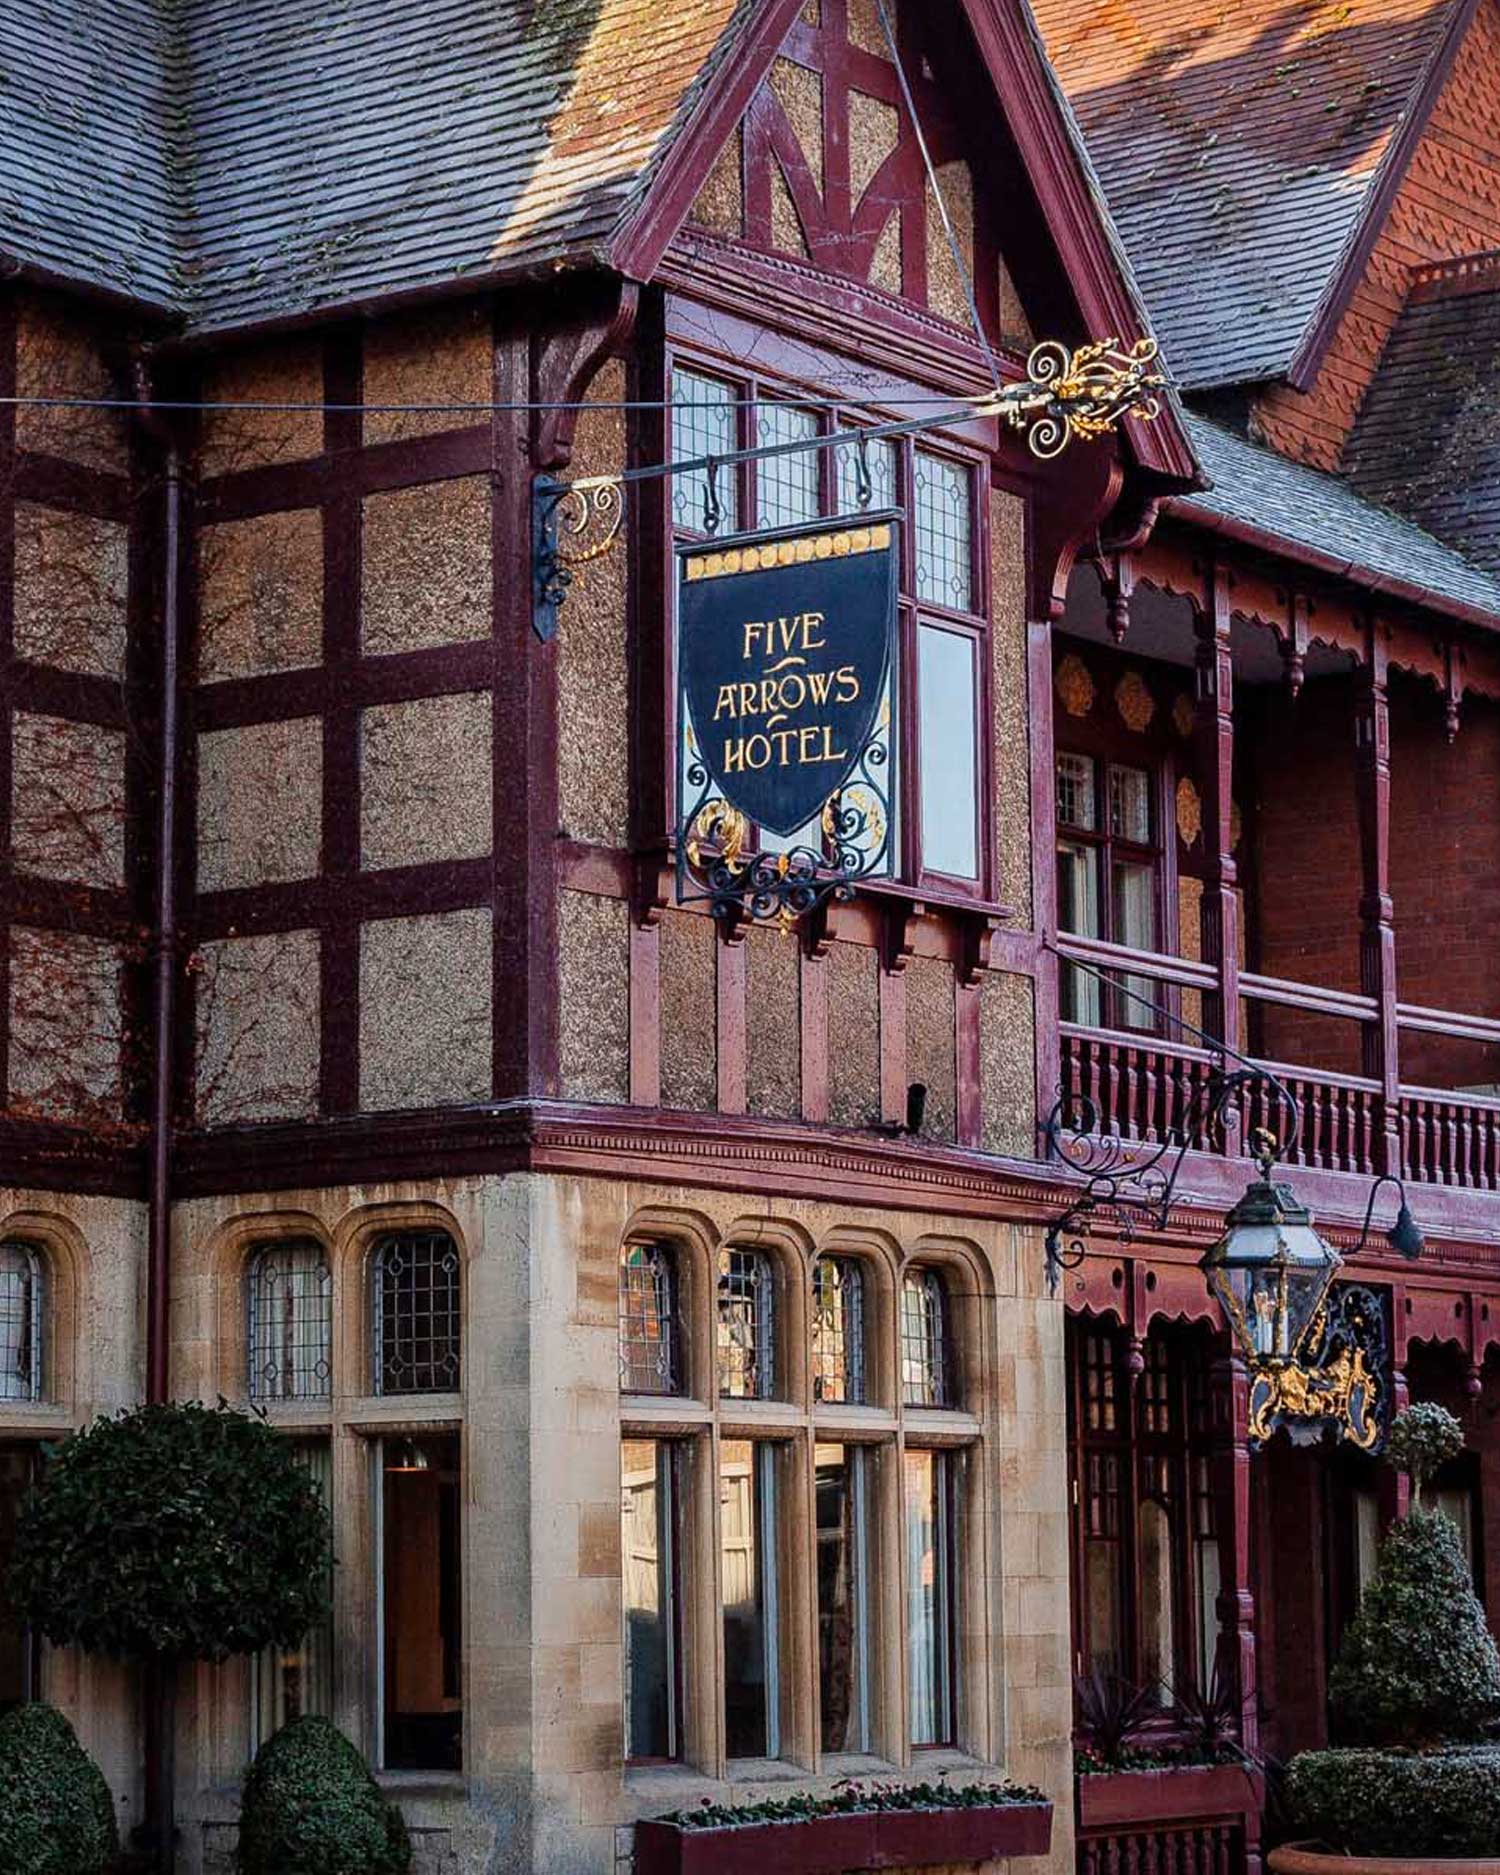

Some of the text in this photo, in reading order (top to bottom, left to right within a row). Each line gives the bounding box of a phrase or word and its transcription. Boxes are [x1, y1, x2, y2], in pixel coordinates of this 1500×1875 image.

[743, 612, 826, 659] FIVE
[713, 666, 860, 721] ARROWS
[723, 727, 848, 773] HOTEL
